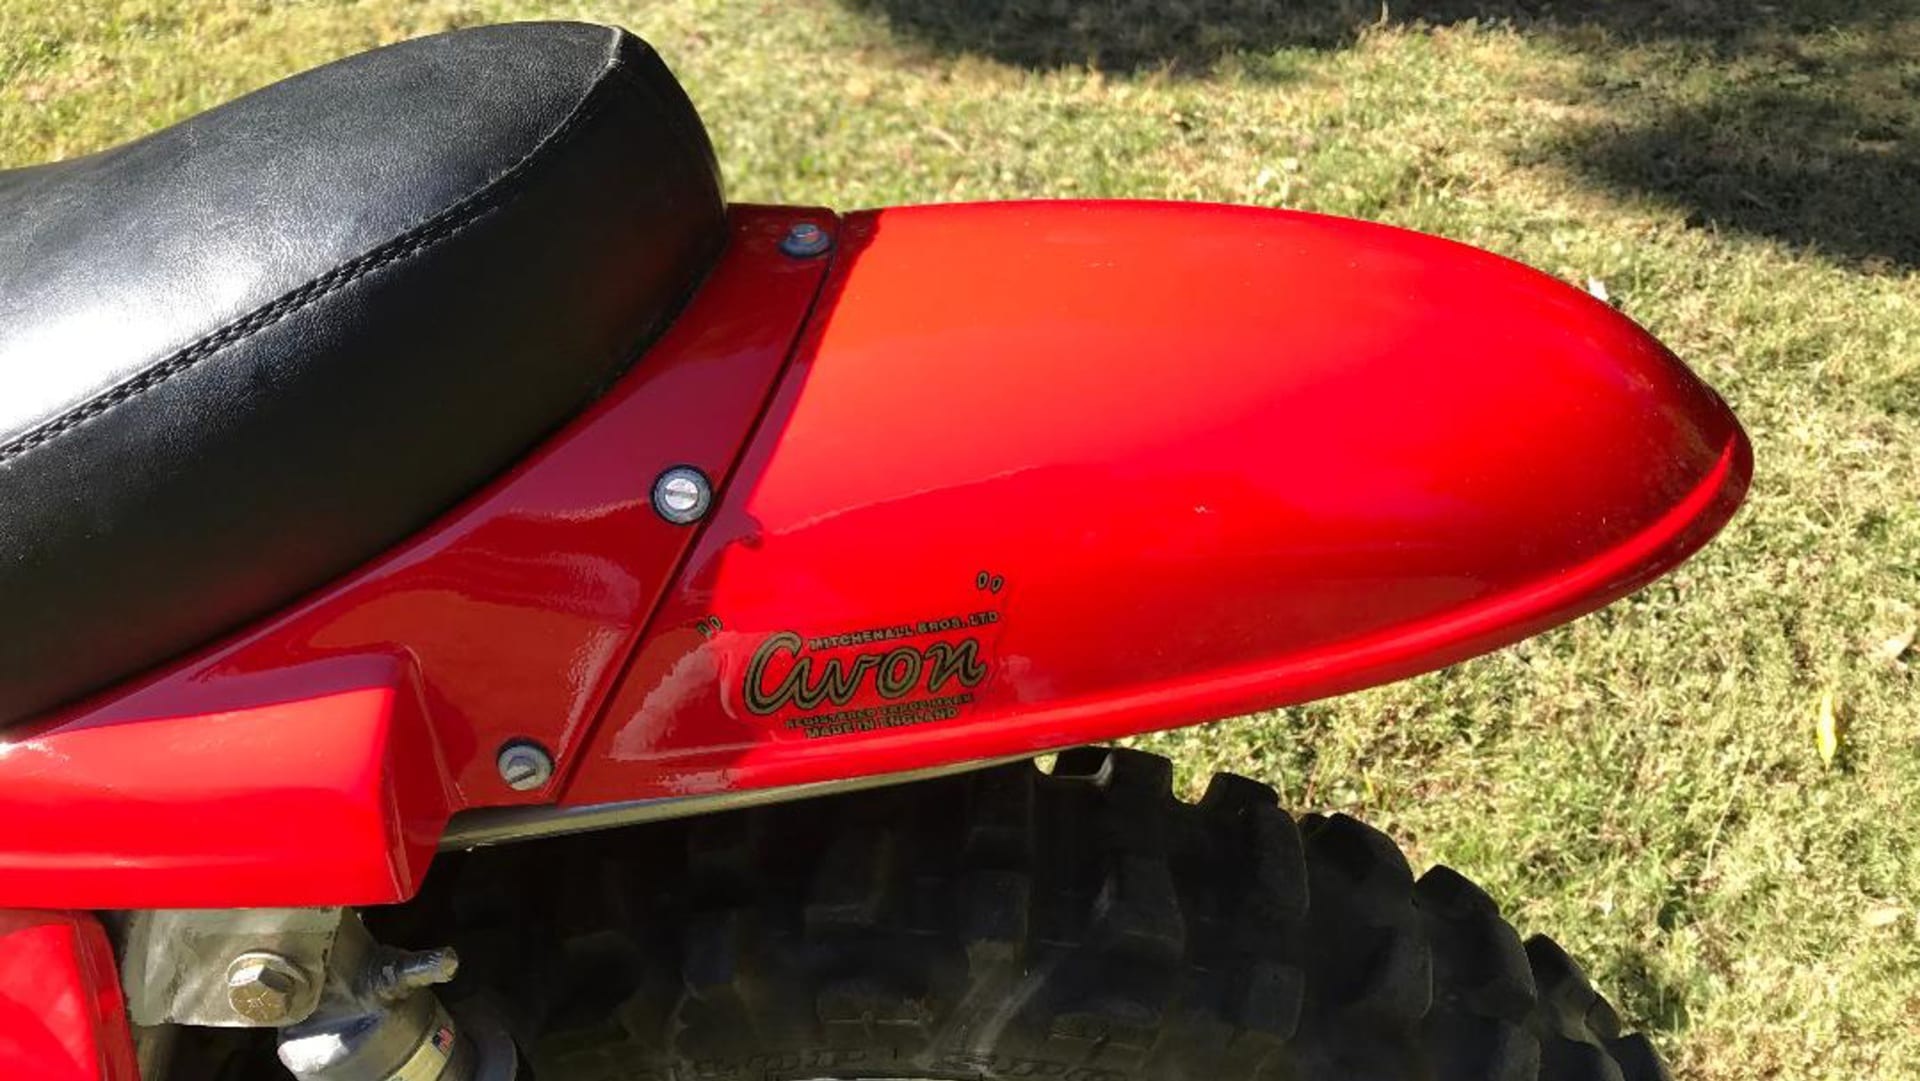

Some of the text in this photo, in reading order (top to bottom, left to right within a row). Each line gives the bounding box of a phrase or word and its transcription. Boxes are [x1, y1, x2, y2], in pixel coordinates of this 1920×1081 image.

[808, 611, 999, 651] MITCHENALL BROS. LTD
[805, 708, 957, 739] MADE IN ENGLAND
